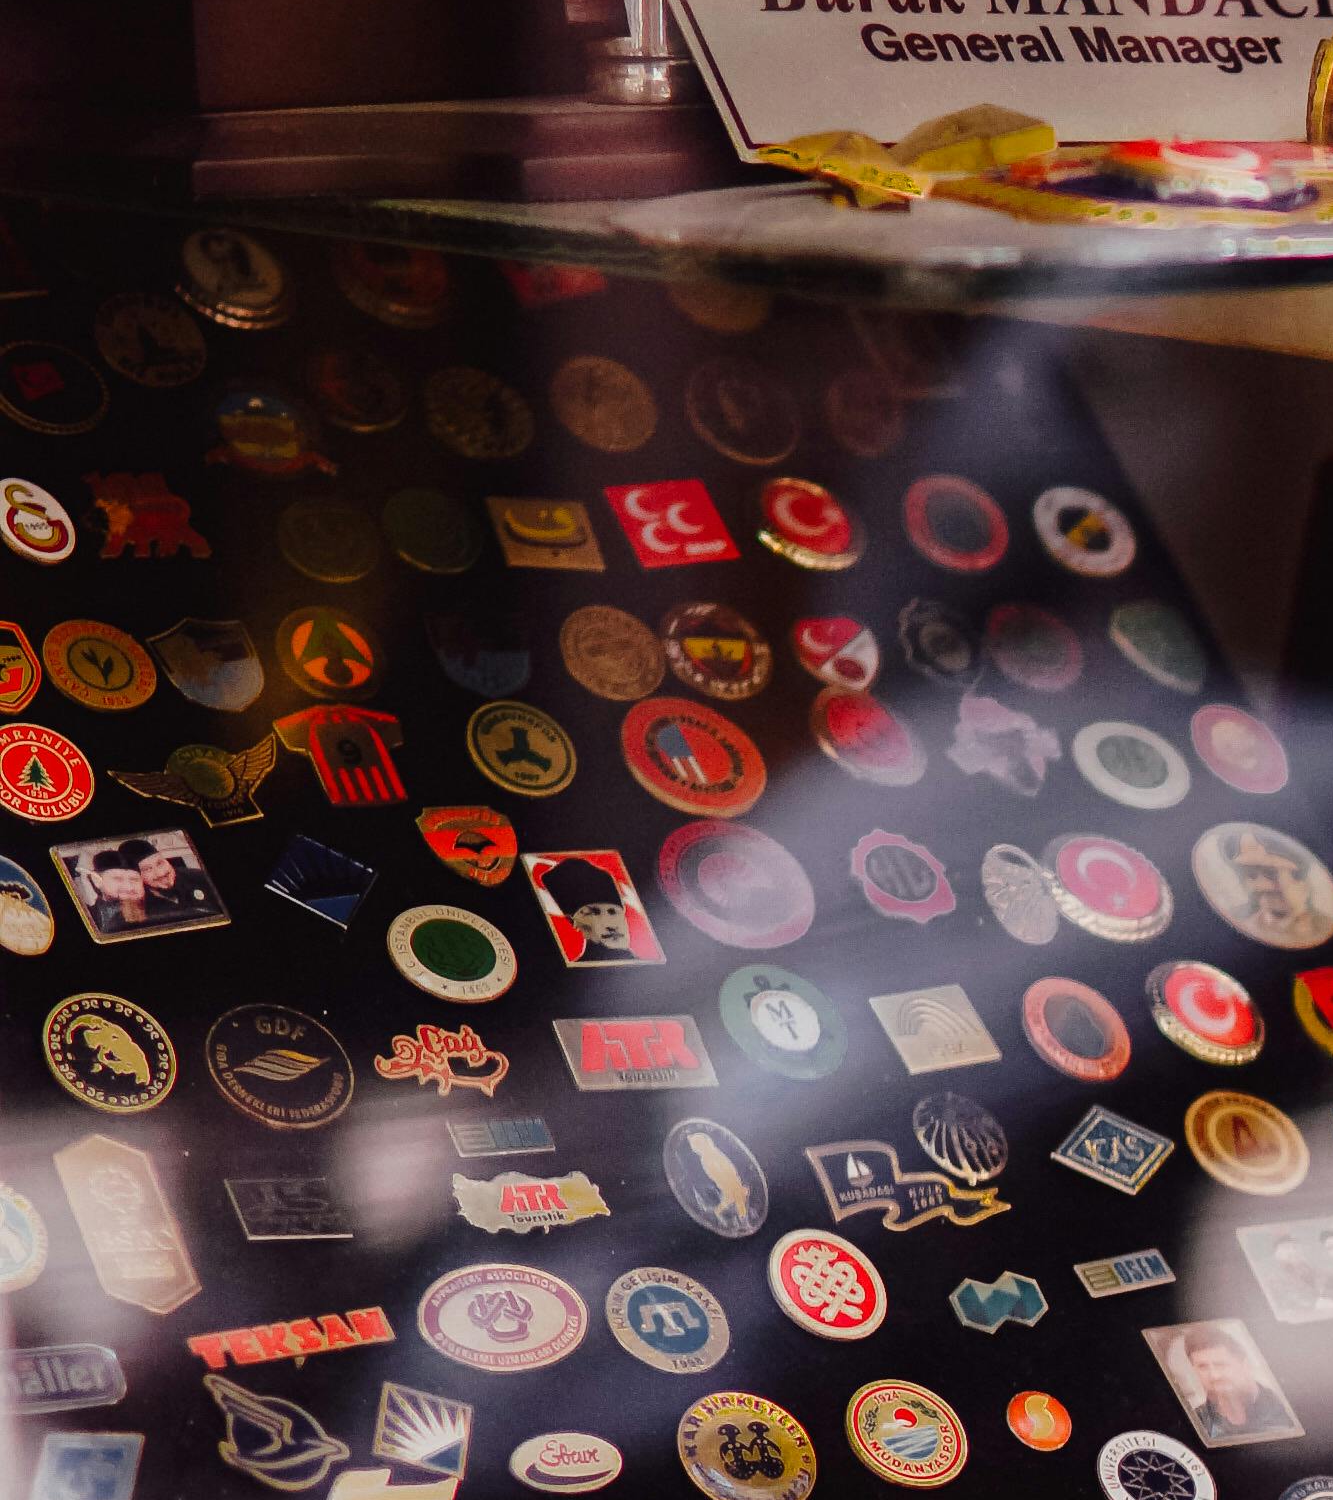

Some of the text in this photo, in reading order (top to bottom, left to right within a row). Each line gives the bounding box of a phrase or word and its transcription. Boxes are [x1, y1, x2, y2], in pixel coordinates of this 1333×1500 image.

[861, 23, 1284, 75] General Manager
[188, 1309, 391, 1370] TEKSAN
[869, 1424, 951, 1474] MUDANYASPOR
